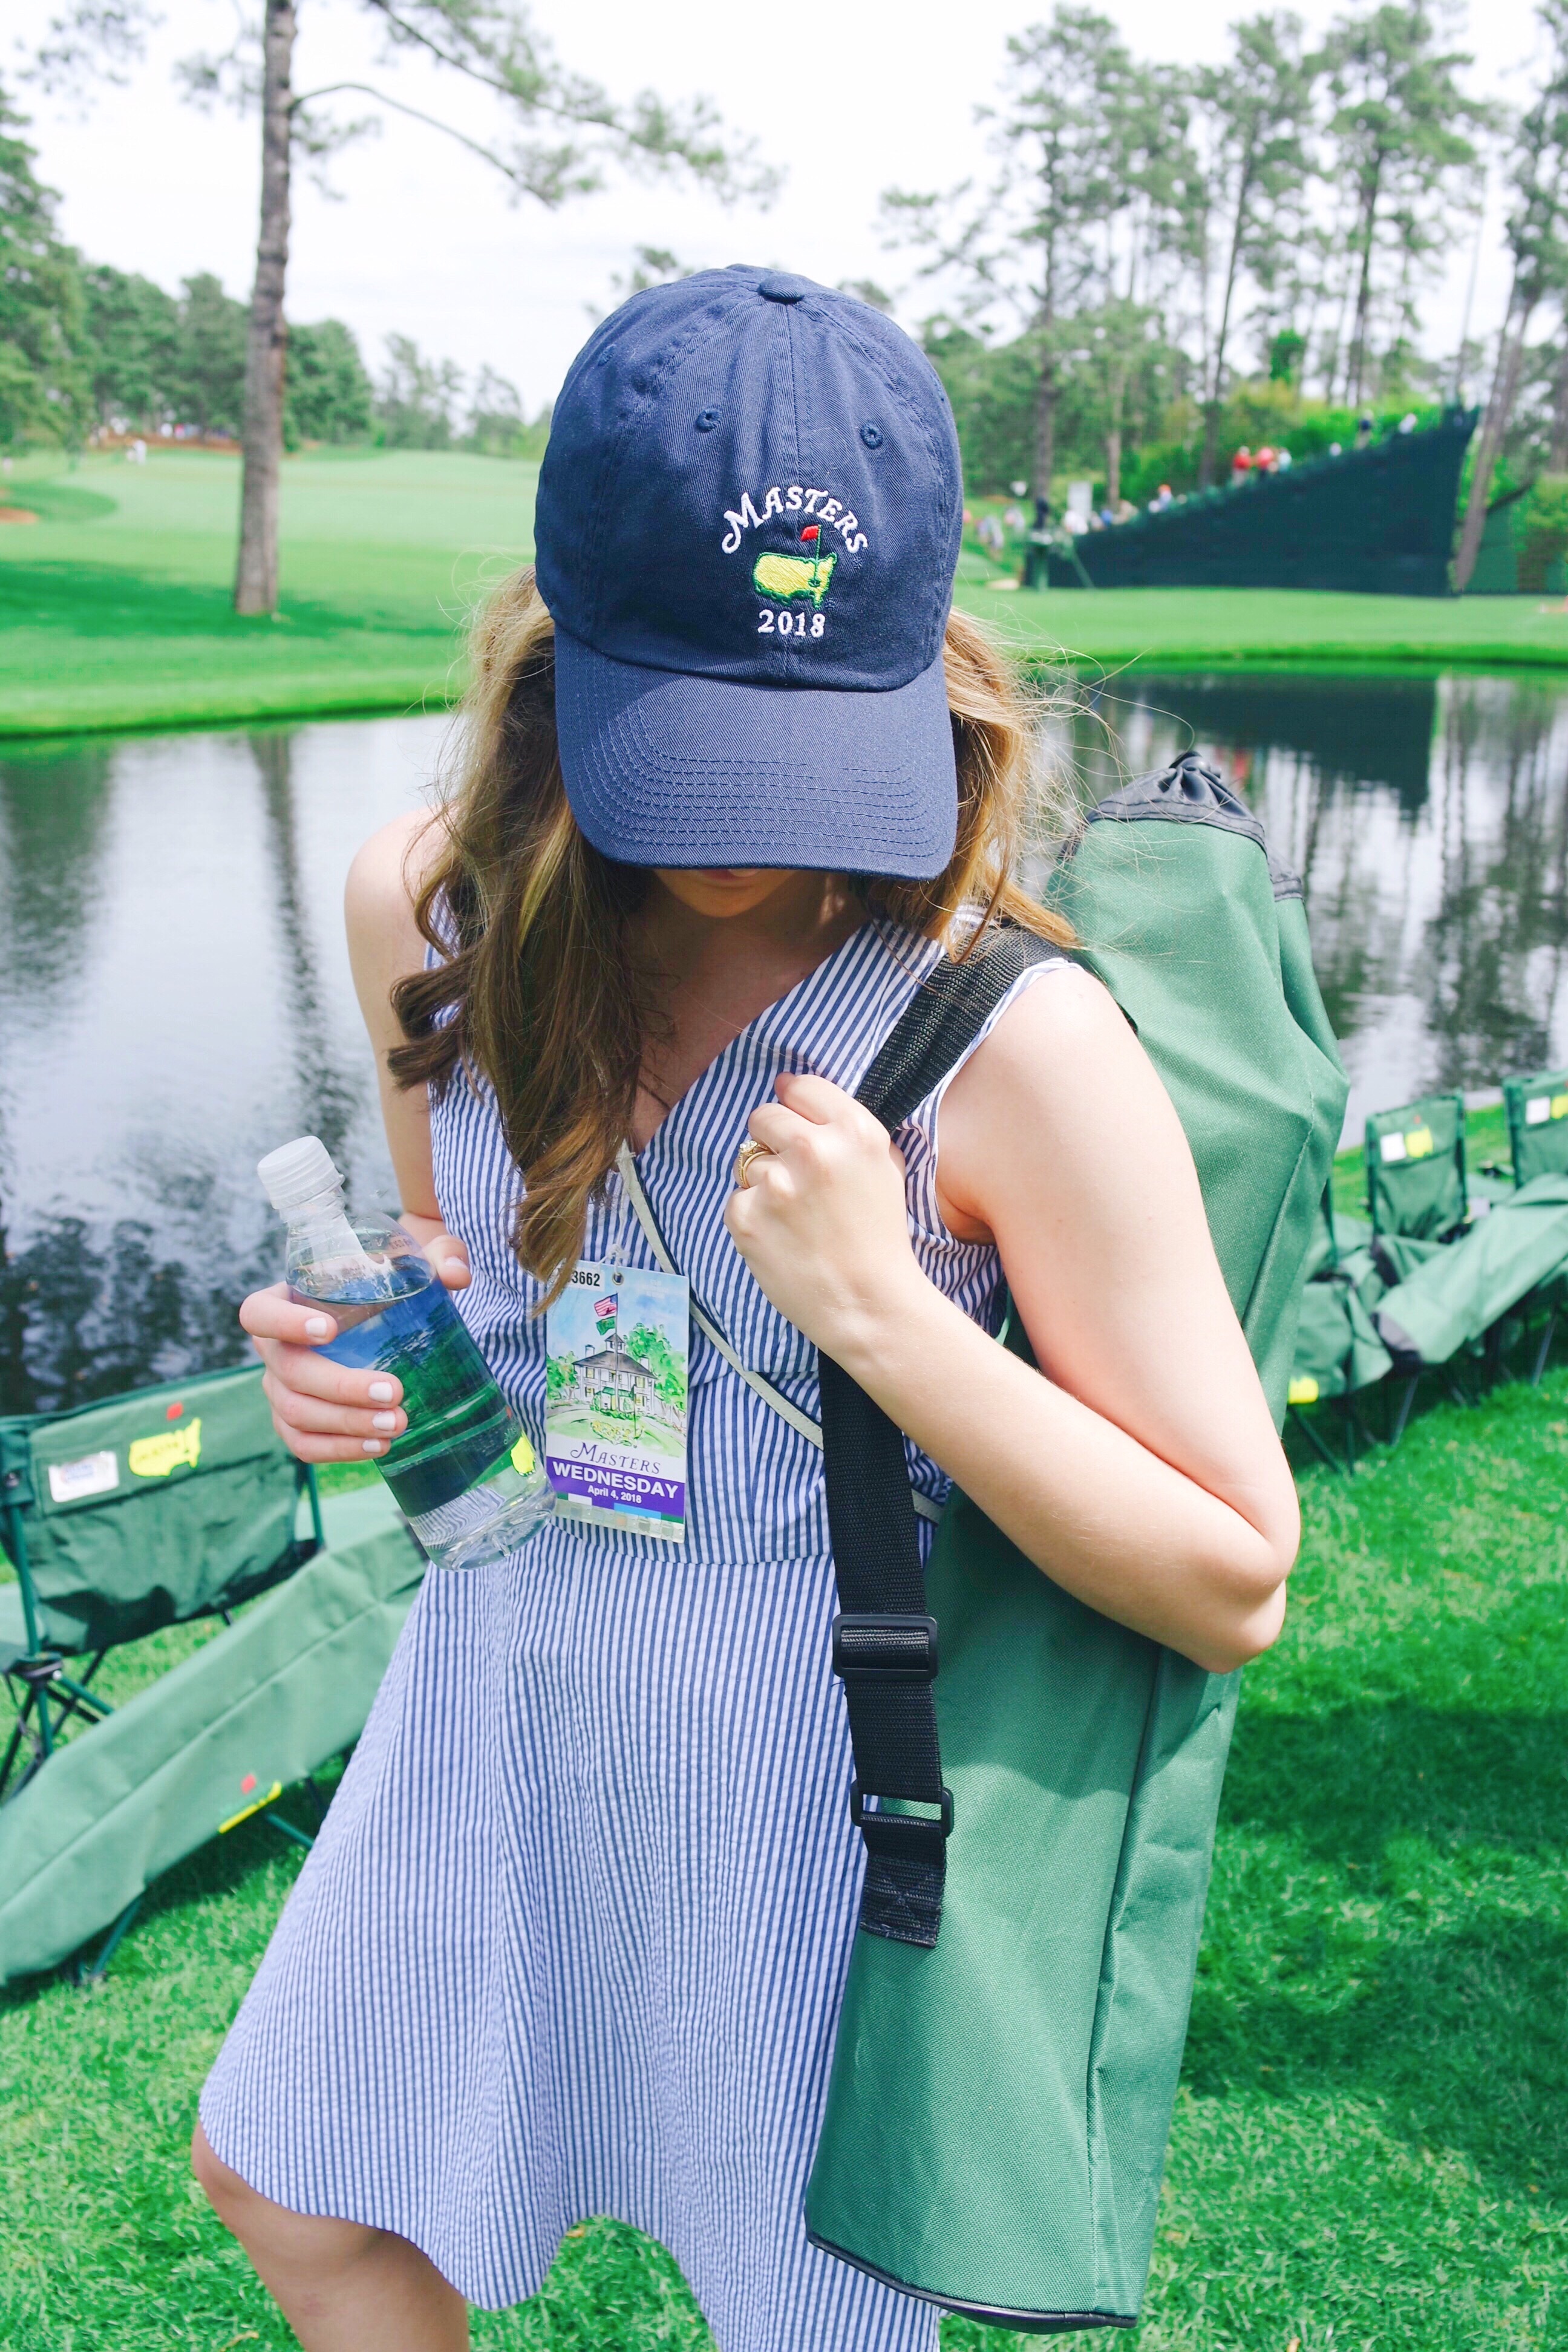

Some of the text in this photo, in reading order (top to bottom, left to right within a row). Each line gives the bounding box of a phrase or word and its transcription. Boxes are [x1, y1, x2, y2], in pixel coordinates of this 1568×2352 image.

[721, 486, 868, 554] MASTERS
[757, 609, 826, 638] 2018
[570, 1442, 661, 1474] MASTERS
[552, 1461, 679, 1499] WEDNESDAY
[587, 1485, 642, 1503] April 4, 2018
